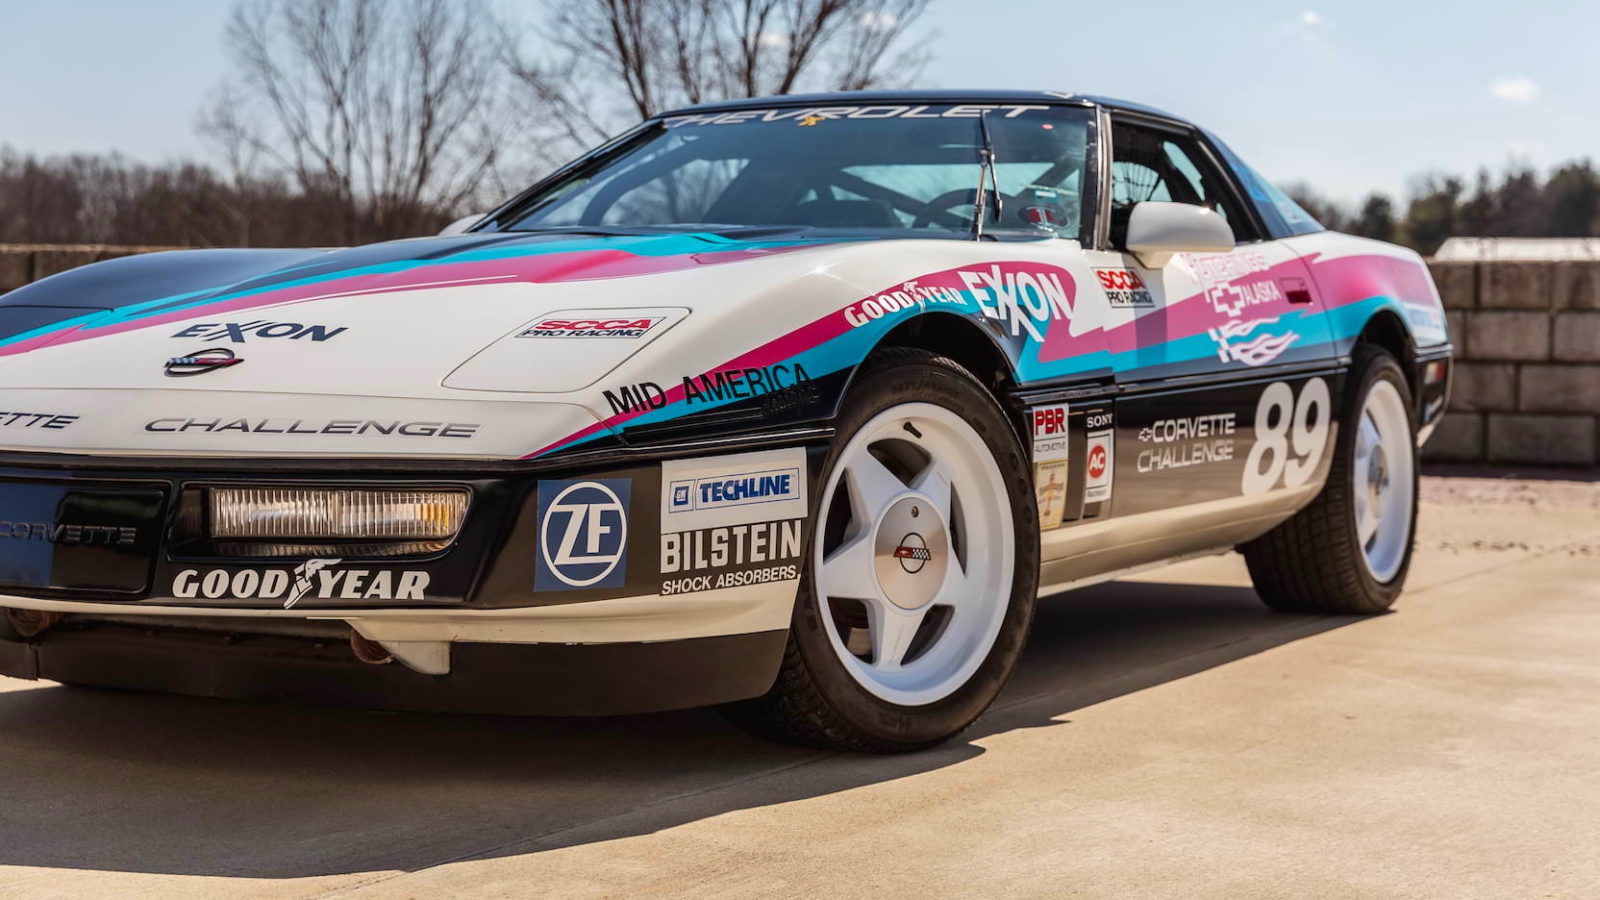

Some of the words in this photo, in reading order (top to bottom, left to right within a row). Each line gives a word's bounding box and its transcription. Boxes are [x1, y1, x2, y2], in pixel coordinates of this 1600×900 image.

[1096, 270, 1147, 289] SCCA
[958, 264, 1074, 342] EXXON
[1106, 291, 1124, 304] PRO
[171, 320, 348, 344] EXXON
[521, 329, 564, 337] PRO
[566, 329, 645, 337] RACING
[535, 319, 652, 330] SCCA
[602, 382, 667, 416] MID
[681, 363, 812, 405] AMERICA
[0, 411, 80, 429] TTE
[144, 417, 481, 438] CHALLENGE
[1035, 408, 1066, 435] PBR
[1086, 413, 1113, 428] SONY
[1152, 413, 1236, 443] CORVETTE
[1242, 377, 1331, 496] 89
[1089, 450, 1106, 472] AC
[1137, 440, 1233, 473] CHALLENGE
[700, 475, 790, 503] TECHLINE
[549, 500, 623, 568] ZF
[660, 519, 801, 574] BILSTEIN
[662, 576, 712, 595] SHOCK
[715, 565, 797, 588] ABSORBERS
